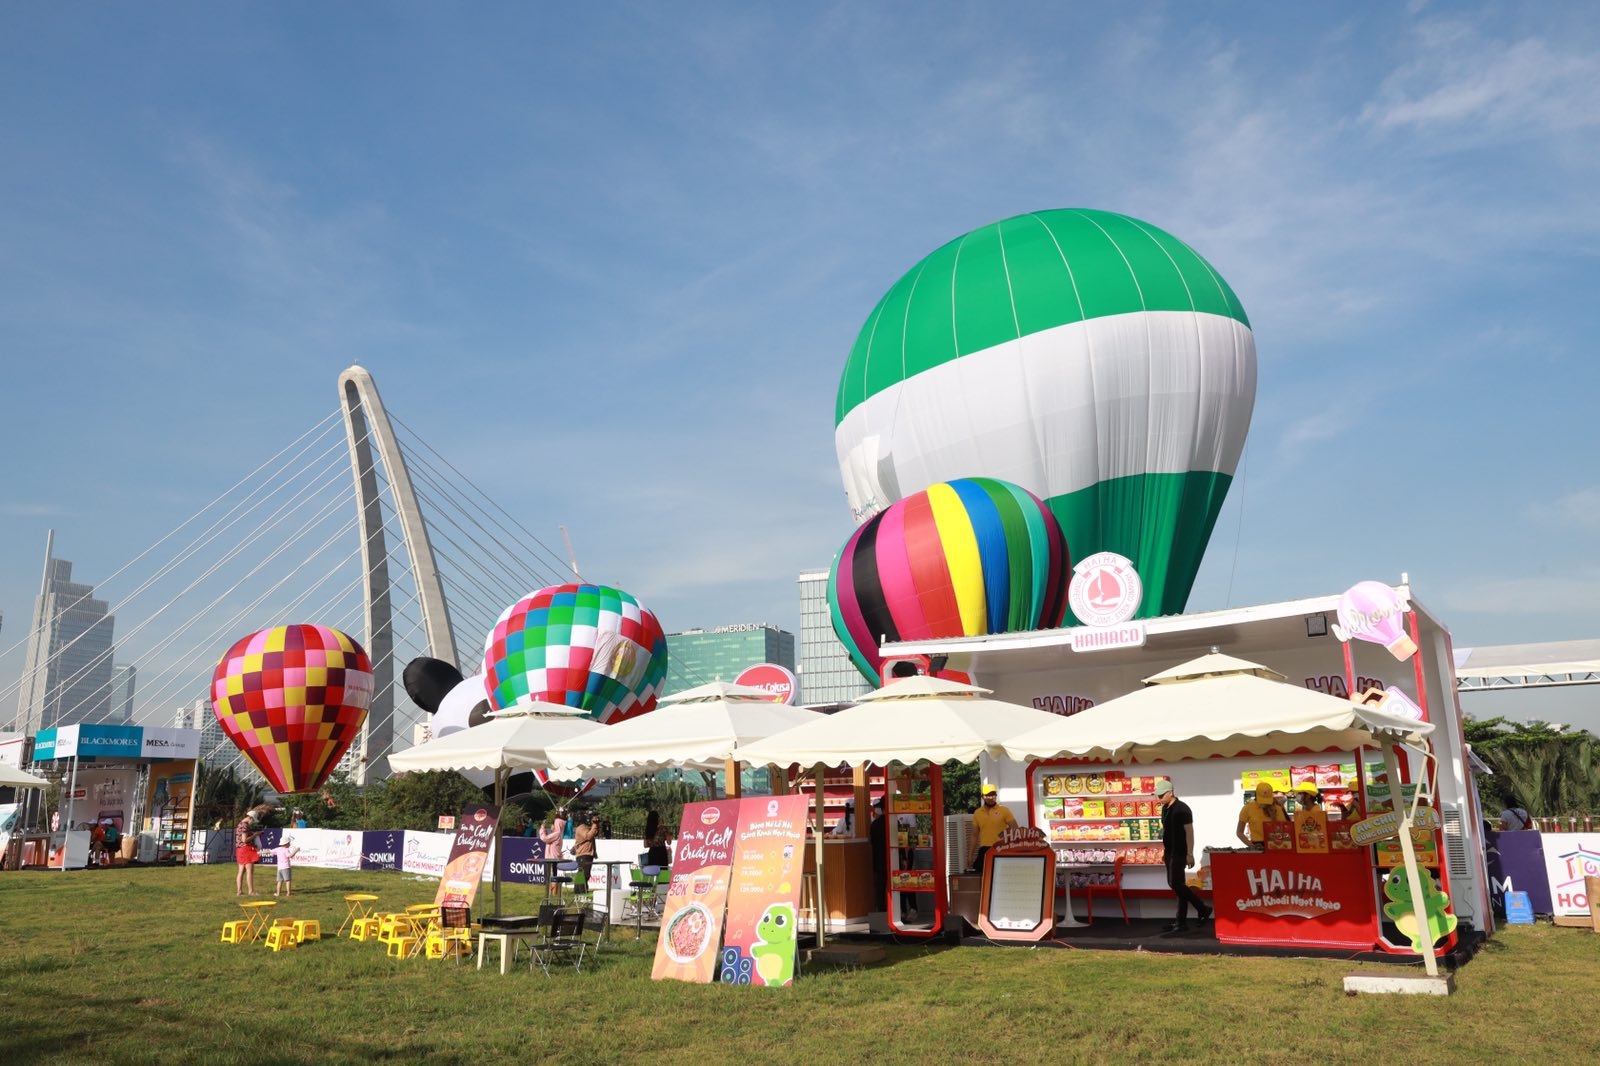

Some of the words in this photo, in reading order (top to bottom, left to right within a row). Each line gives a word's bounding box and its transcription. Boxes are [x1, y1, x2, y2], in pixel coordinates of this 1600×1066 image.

[1074, 628, 1140, 649] HAIHACO
[80, 737, 138, 746] BLACKMORES
[146, 739, 170, 747] MESA
[369, 852, 396, 863] SONKIM
[509, 862, 545, 876] SONKIM
[669, 882, 689, 897] 30K
